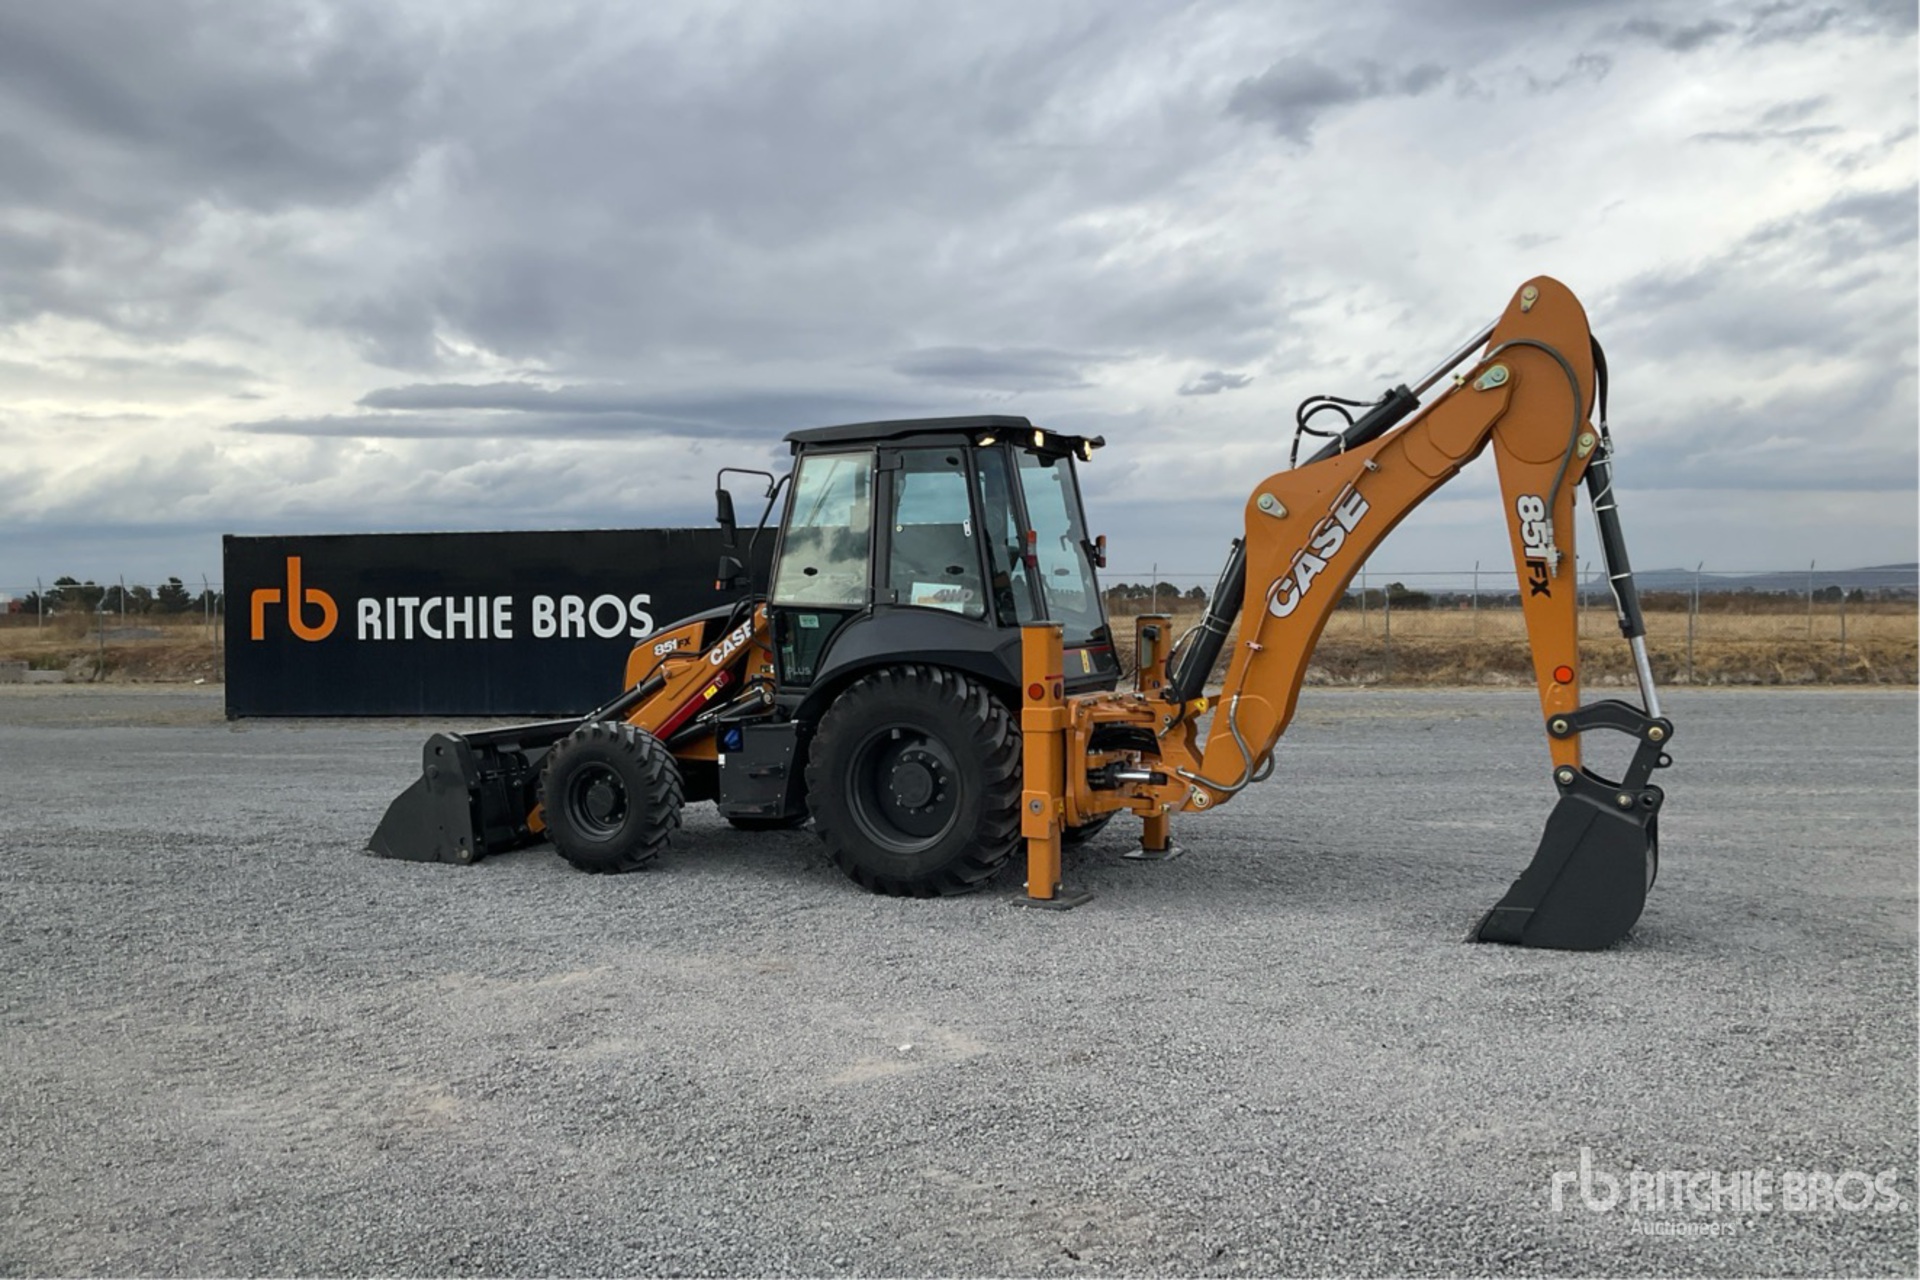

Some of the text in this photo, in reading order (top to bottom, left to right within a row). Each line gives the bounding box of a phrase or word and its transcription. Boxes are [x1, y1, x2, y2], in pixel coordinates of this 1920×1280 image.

[250, 556, 339, 642] rb
[357, 595, 513, 641] RITCHIE
[1266, 481, 1371, 619] CASE
